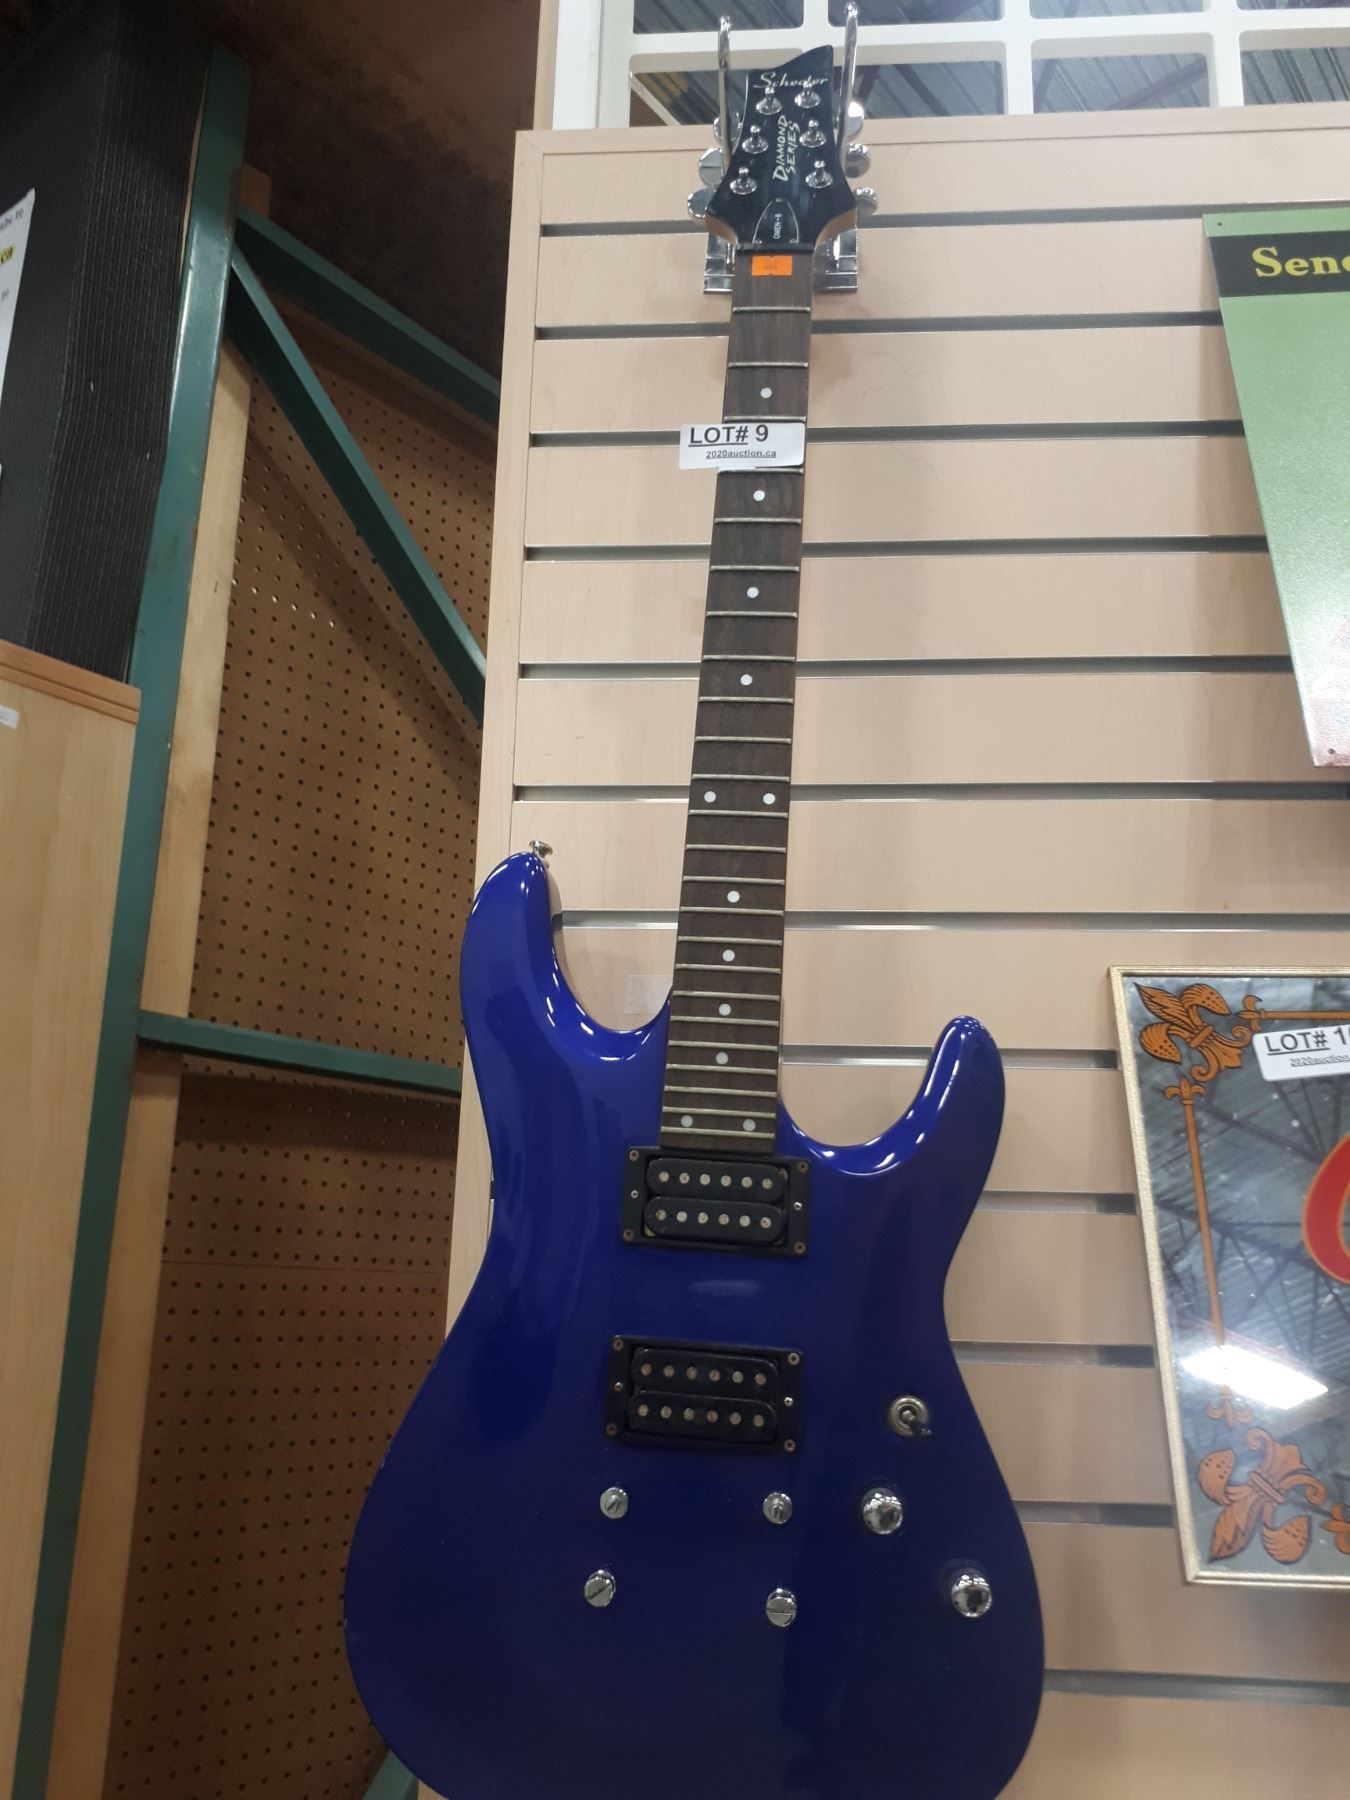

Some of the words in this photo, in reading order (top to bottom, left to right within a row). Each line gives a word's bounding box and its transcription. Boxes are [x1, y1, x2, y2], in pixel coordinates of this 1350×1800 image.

[785, 120, 801, 176] SERIES
[689, 425, 749, 445] LOT#
[755, 424, 769, 442] 9
[705, 449, 777, 459] 2020auction.ca
[1264, 1029, 1329, 1054] LOT#
[1333, 1026, 1350, 1046] 1
